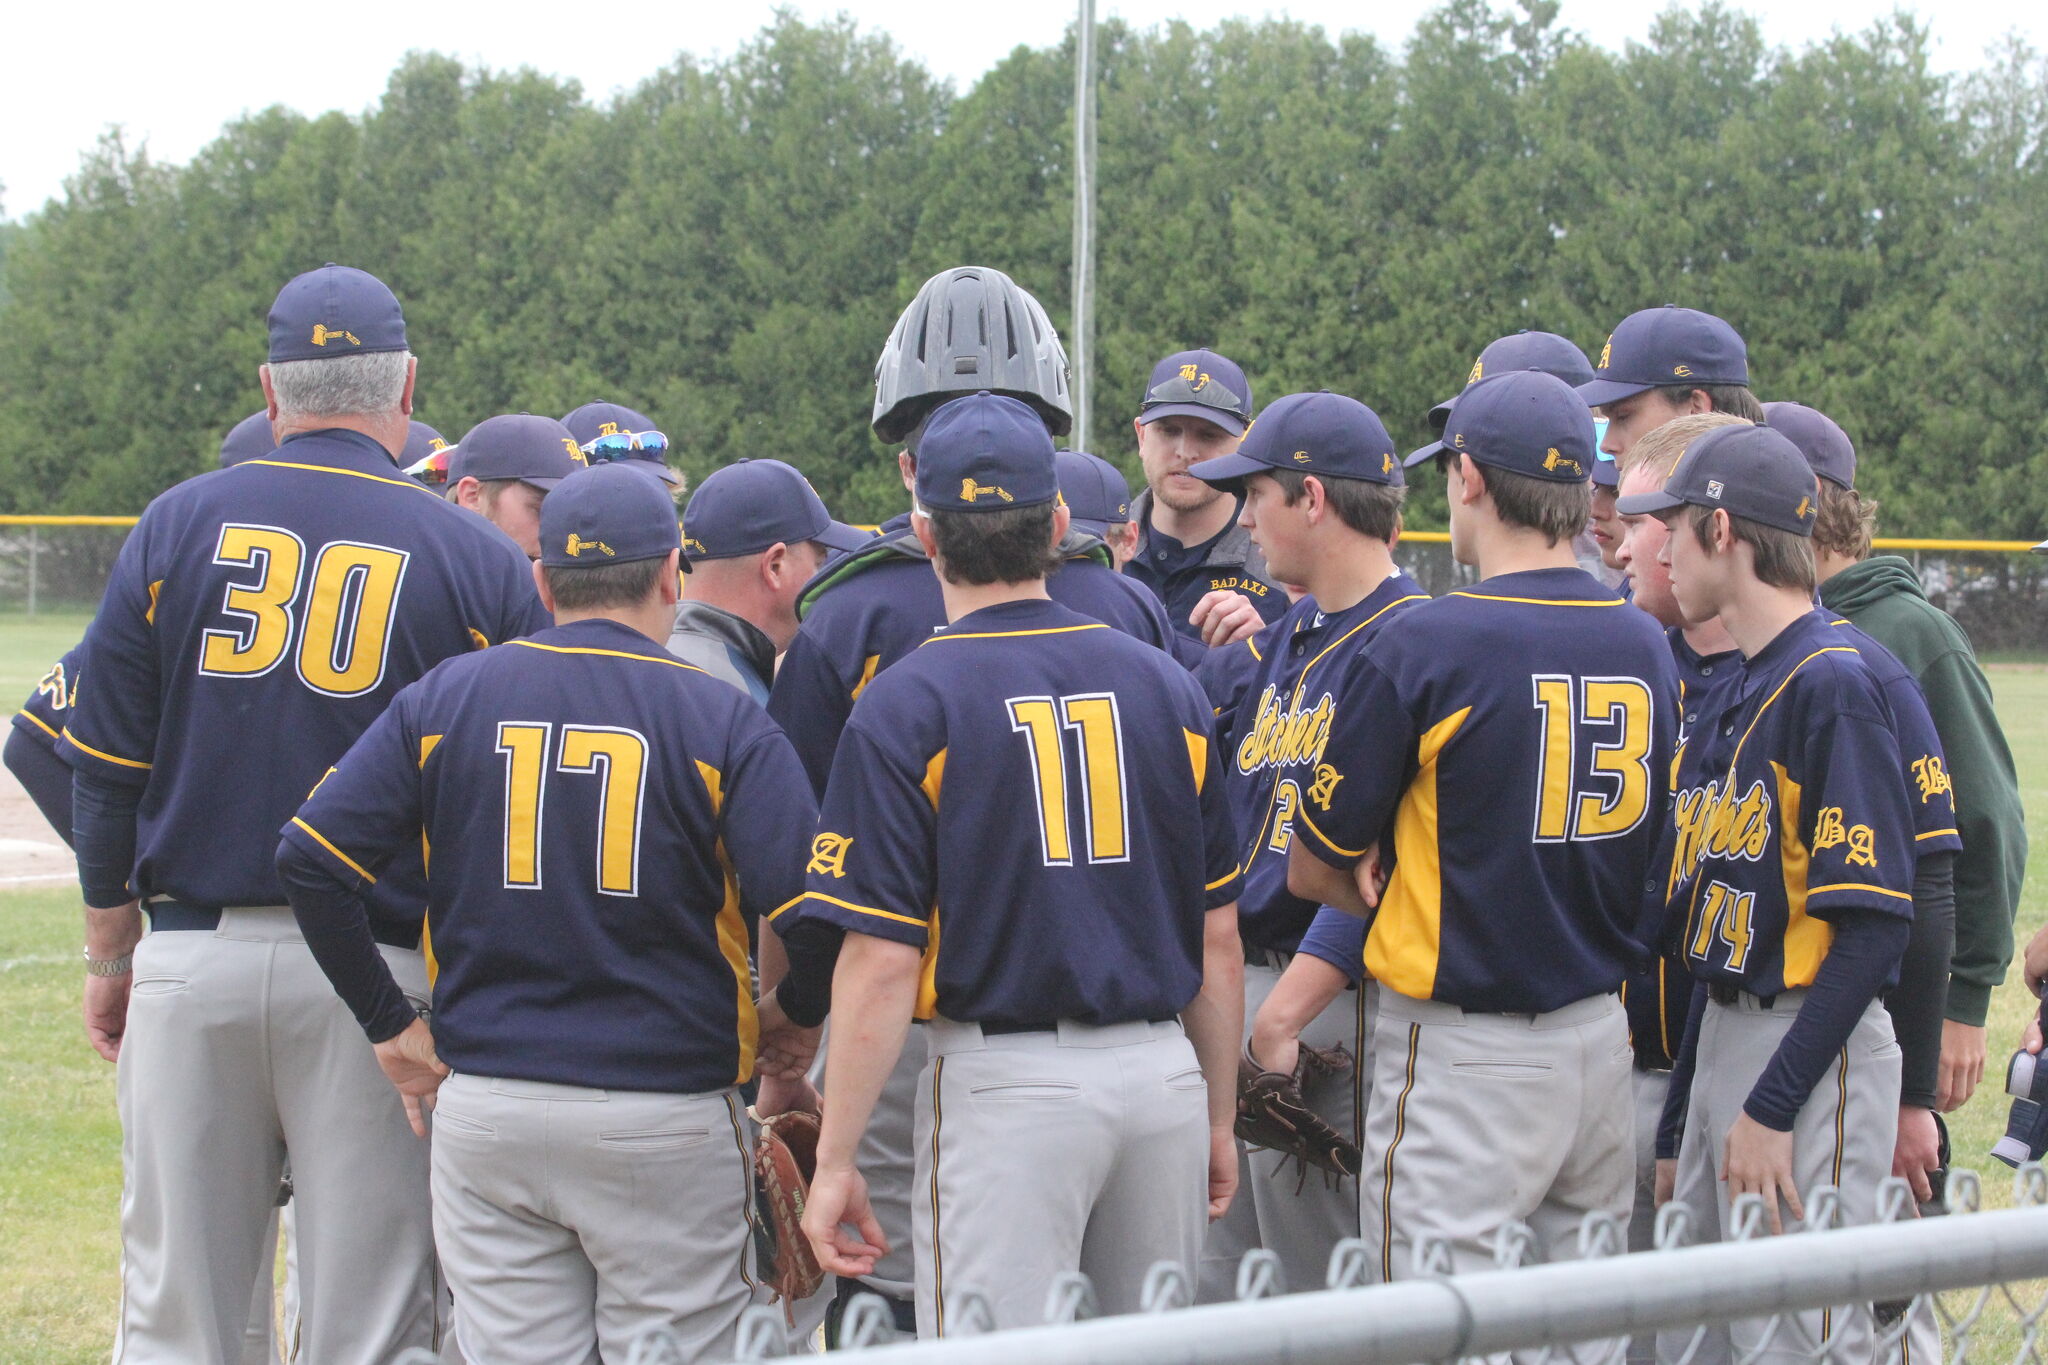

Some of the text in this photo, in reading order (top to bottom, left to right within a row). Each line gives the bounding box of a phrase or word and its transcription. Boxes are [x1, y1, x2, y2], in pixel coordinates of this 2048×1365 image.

[199, 523, 411, 698] 30
[1210, 577, 1268, 597] BAD AXE
[1004, 691, 1131, 867] 11
[1530, 673, 1654, 844] 13
[1911, 754, 1955, 814] B
[495, 721, 650, 897] 17
[806, 832, 854, 878] A
[1811, 806, 1878, 868] BA
[1689, 879, 1756, 974] 14
